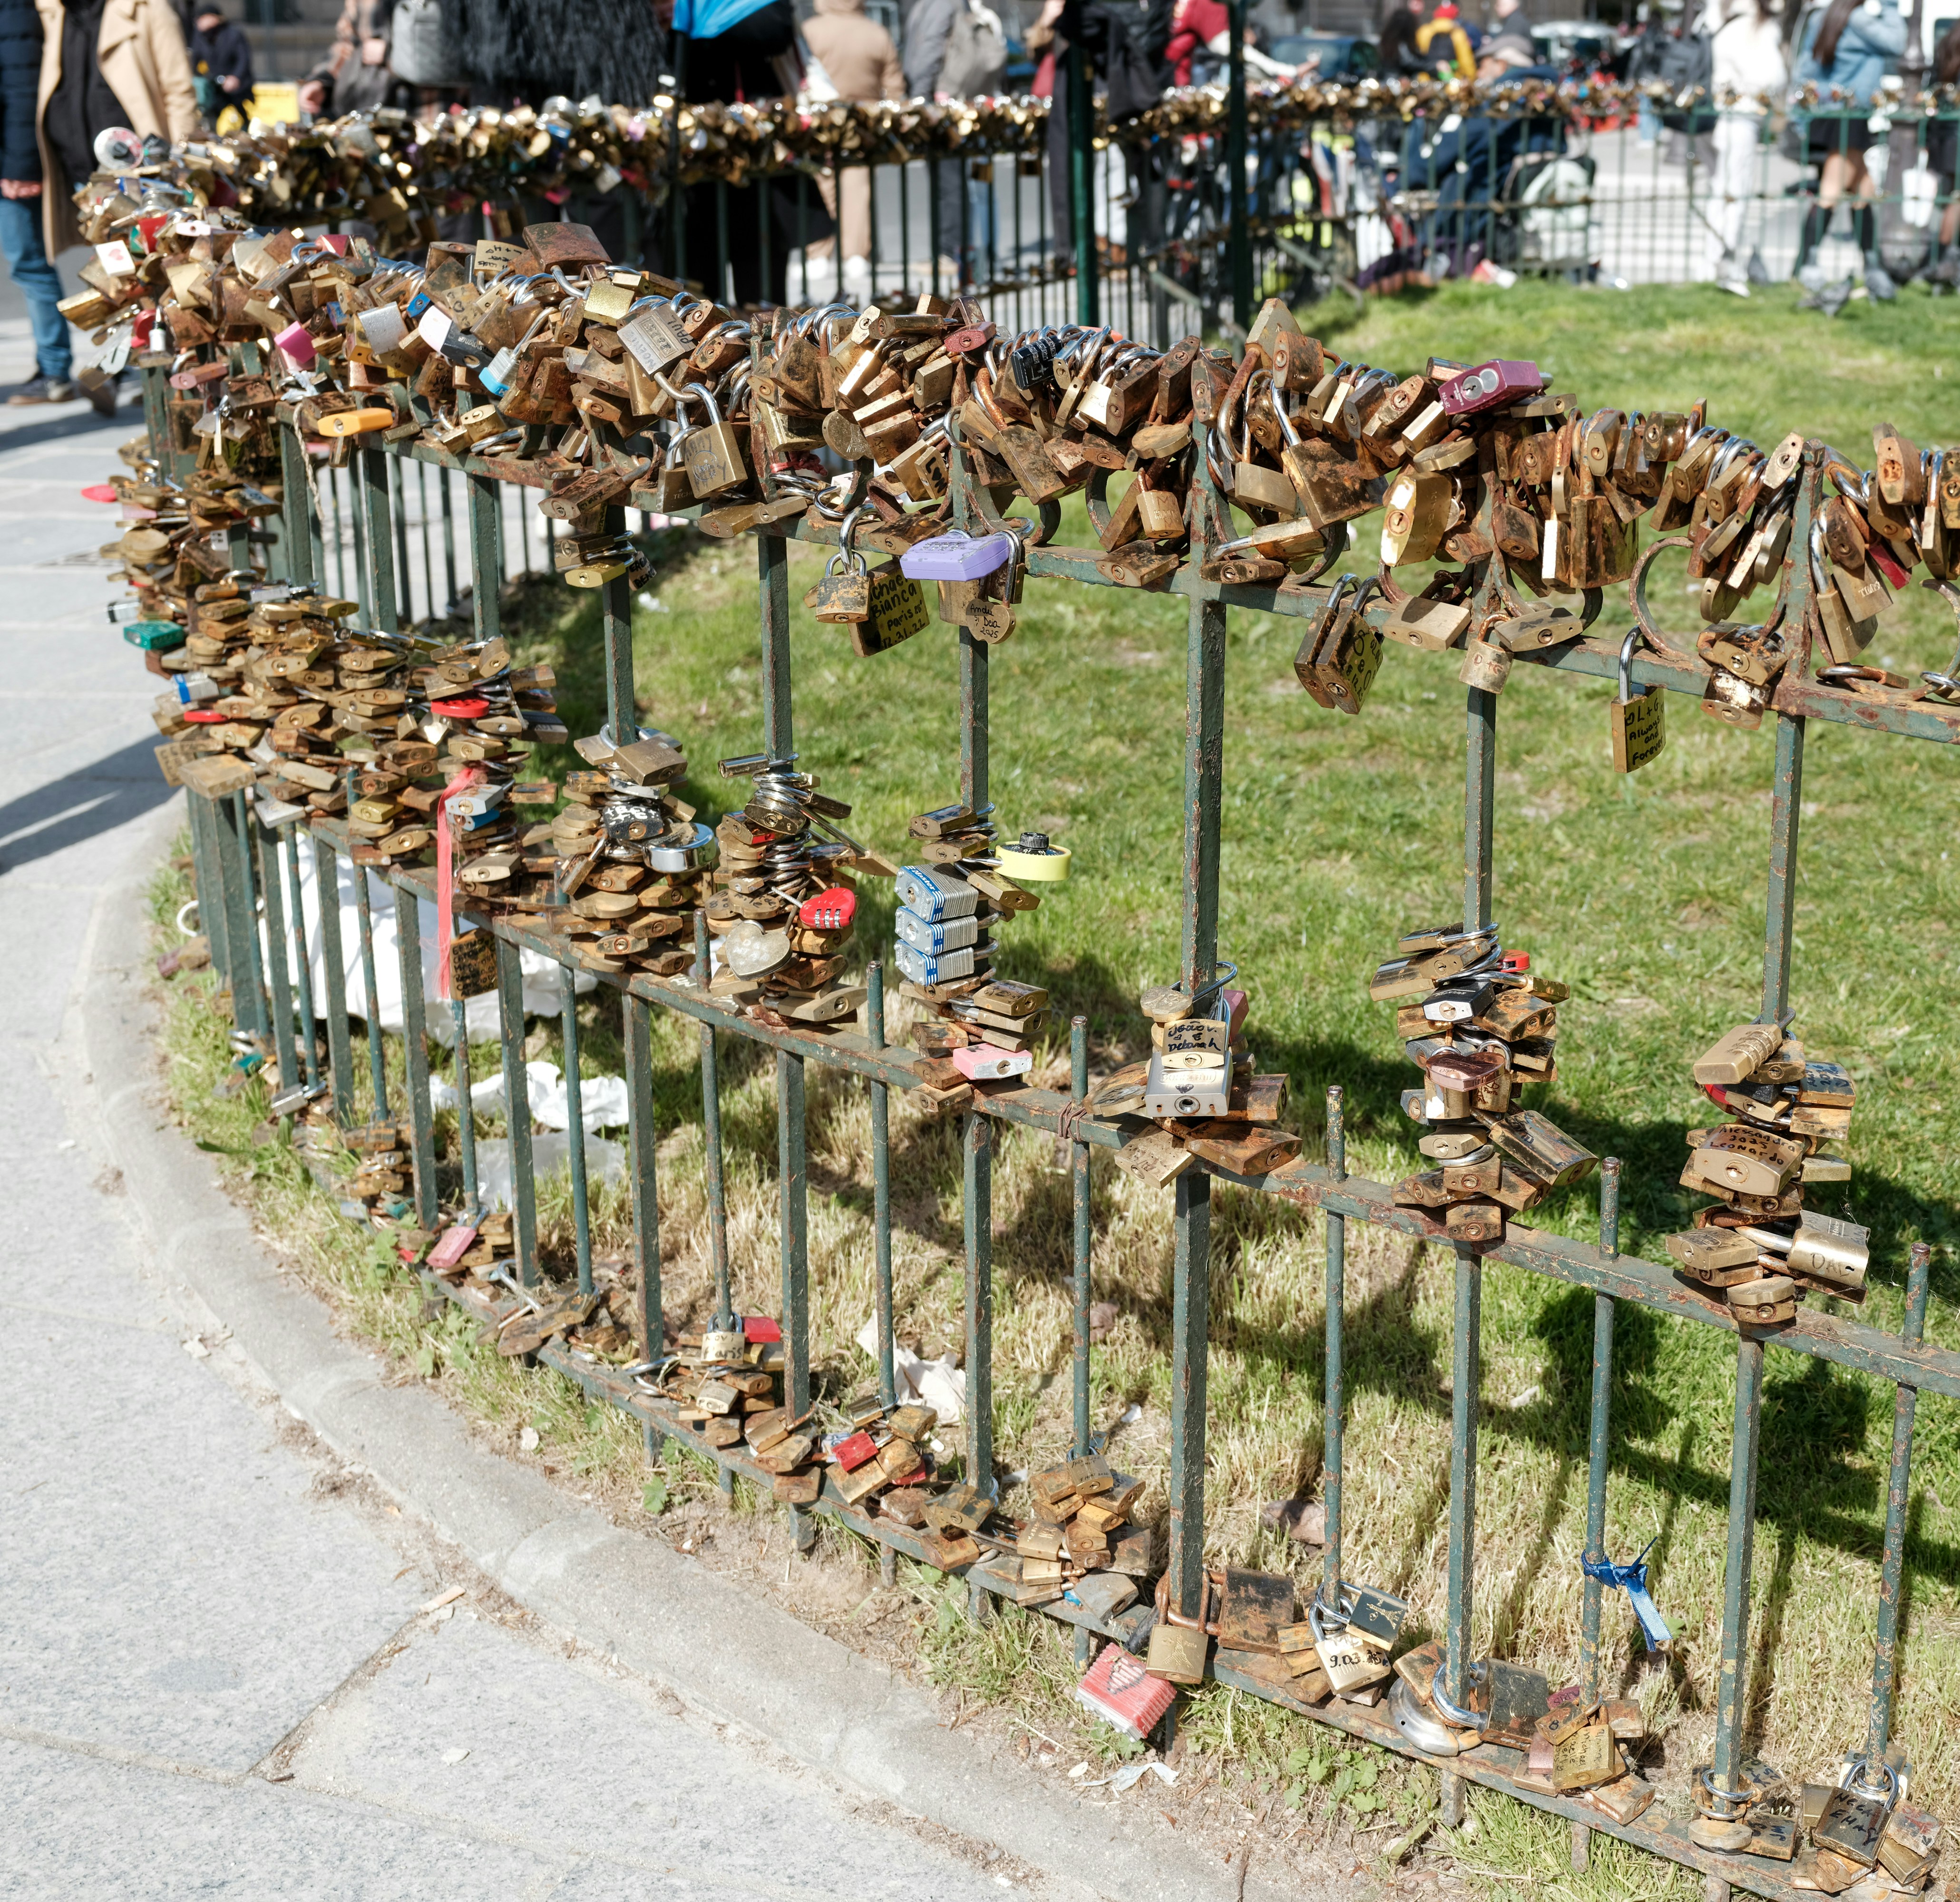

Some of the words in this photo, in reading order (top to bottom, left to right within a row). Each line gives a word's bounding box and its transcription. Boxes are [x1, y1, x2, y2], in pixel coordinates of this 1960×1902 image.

[667, 315, 692, 344] PAUL
[980, 627, 998, 639] 2025
[1637, 705, 1645, 722] L
[1629, 715, 1660, 740] Always
[1644, 728, 1658, 744] and
[911, 869, 935, 891] Master
[1719, 1126, 1795, 1152] Alessandra
[1729, 1135, 1768, 1149] 2025
[1554, 1690, 1580, 1706] ARIS
[1549, 1719, 1560, 1731] B
